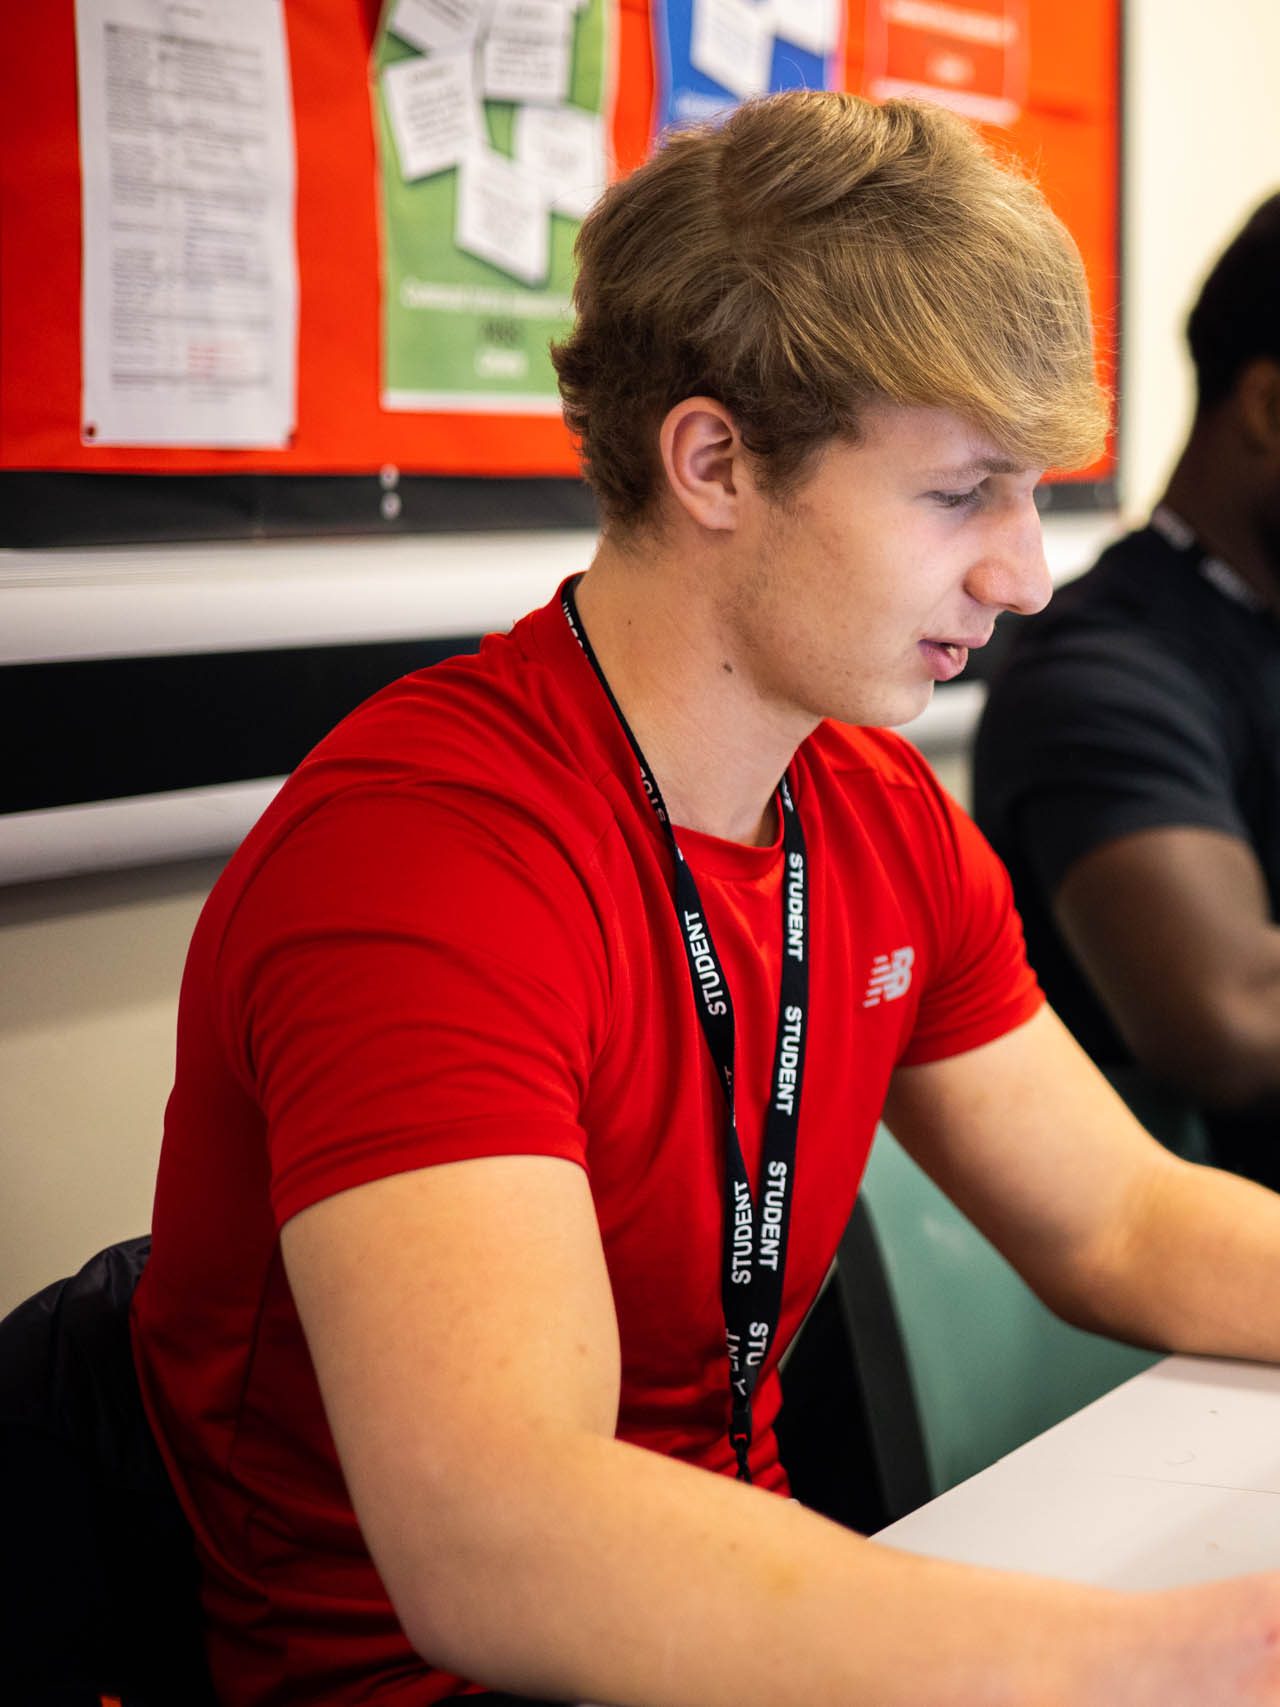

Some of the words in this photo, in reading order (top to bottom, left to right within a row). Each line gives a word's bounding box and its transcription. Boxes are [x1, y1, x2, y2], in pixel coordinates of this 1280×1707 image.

[787, 852, 803, 962] STUDENT
[684, 910, 727, 1016] STUDENT
[776, 1005, 802, 1116] STUDENT
[731, 1181, 752, 1285] STUDENT
[759, 1160, 787, 1271] STUDENT
